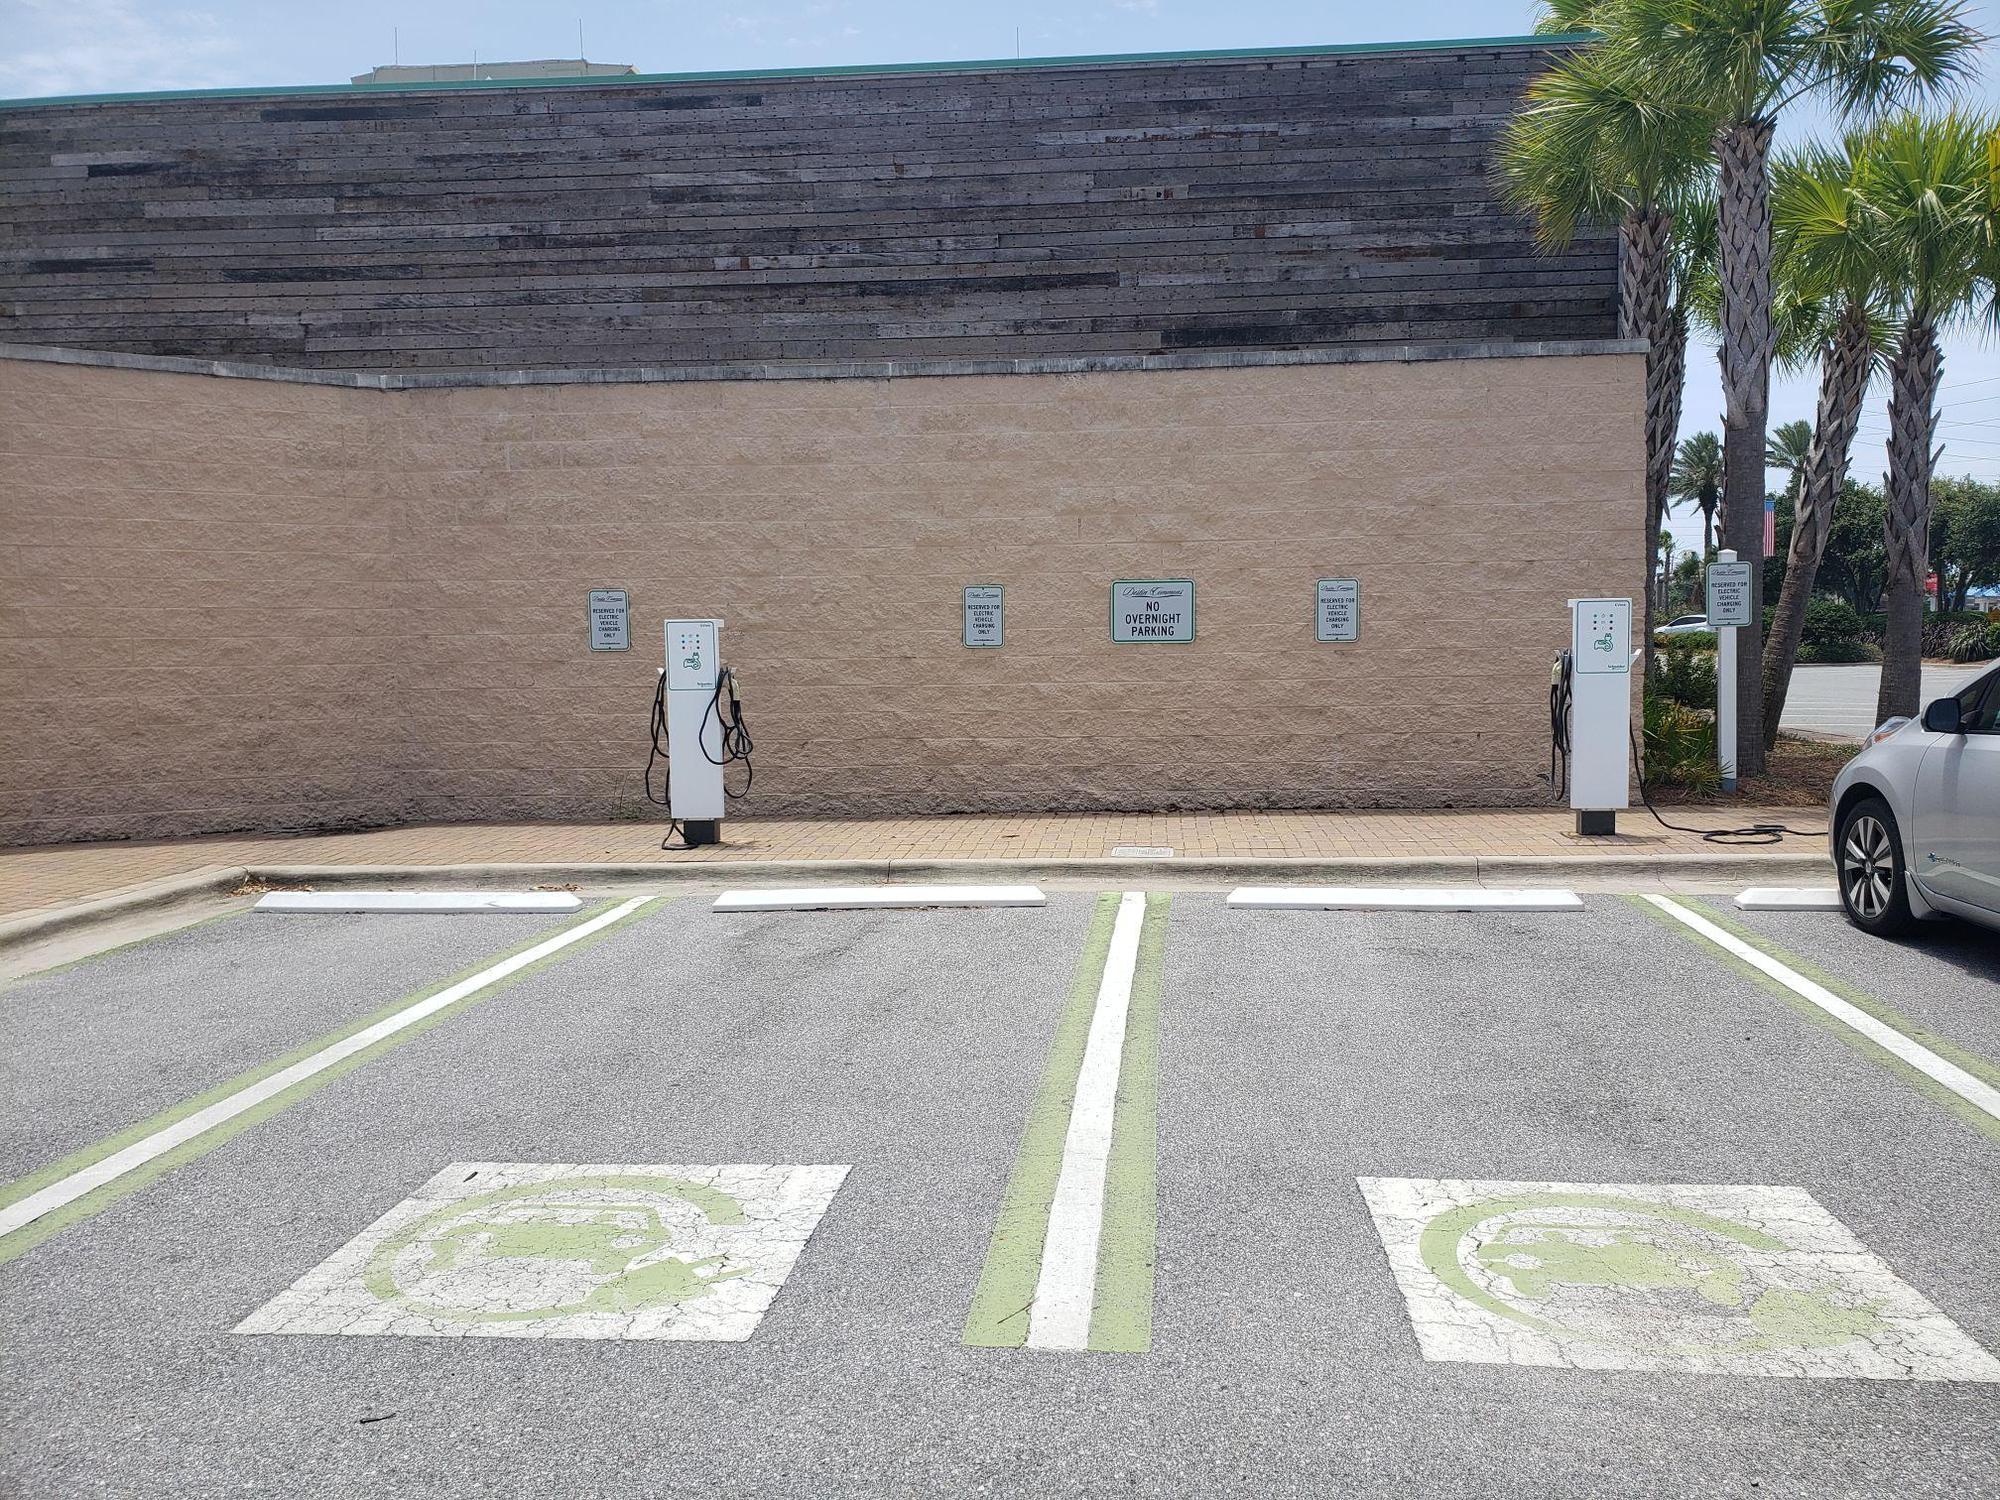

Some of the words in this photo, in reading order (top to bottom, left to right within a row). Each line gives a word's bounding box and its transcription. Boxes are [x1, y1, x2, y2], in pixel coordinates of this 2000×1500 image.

[1146, 601, 1160, 612] NO
[1125, 613, 1181, 625] OVERNIGHT
[1131, 626, 1175, 637] PARKING
